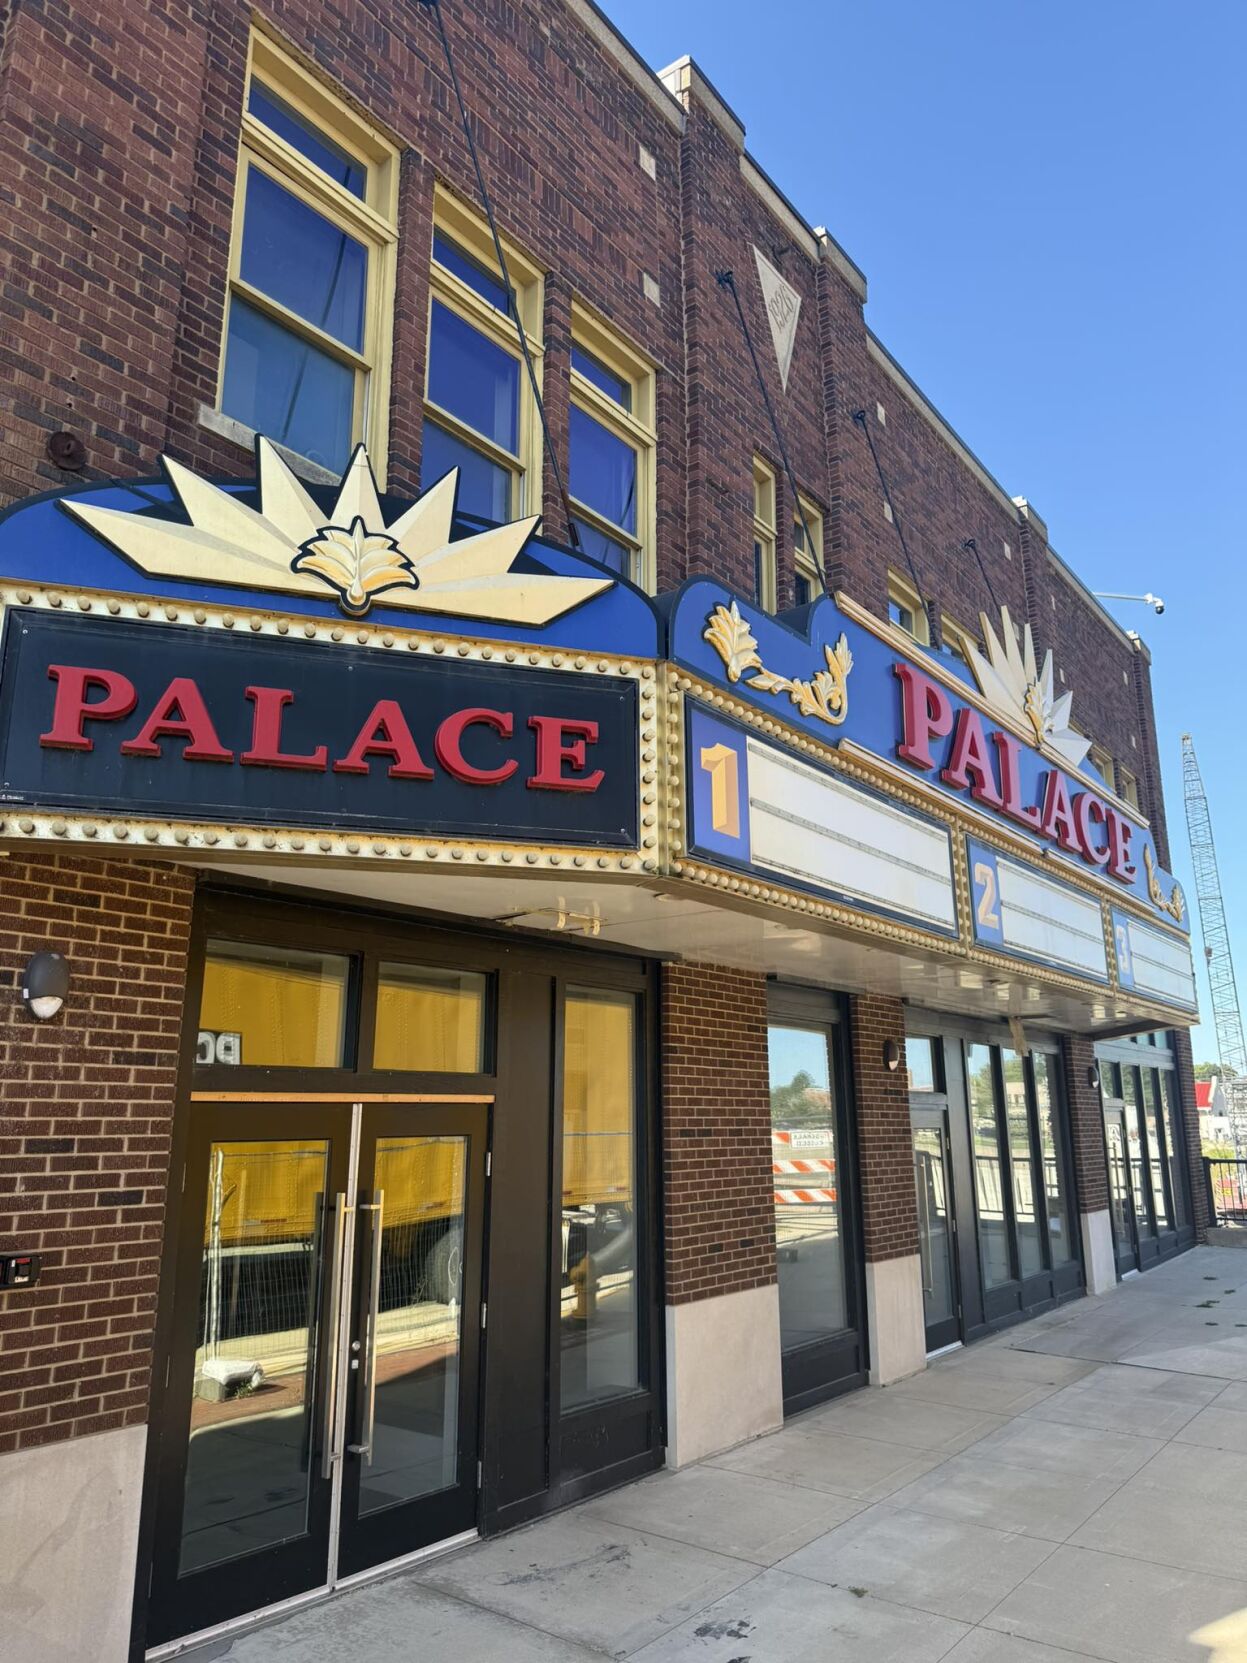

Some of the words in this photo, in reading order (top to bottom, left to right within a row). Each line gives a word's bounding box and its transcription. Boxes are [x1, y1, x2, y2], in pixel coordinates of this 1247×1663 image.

[769, 284, 794, 332] 1926
[39, 664, 605, 792] PALACE
[701, 743, 740, 839] 1
[893, 662, 1137, 884] PALACE
[974, 862, 999, 930] 2
[1115, 921, 1131, 976] 3
